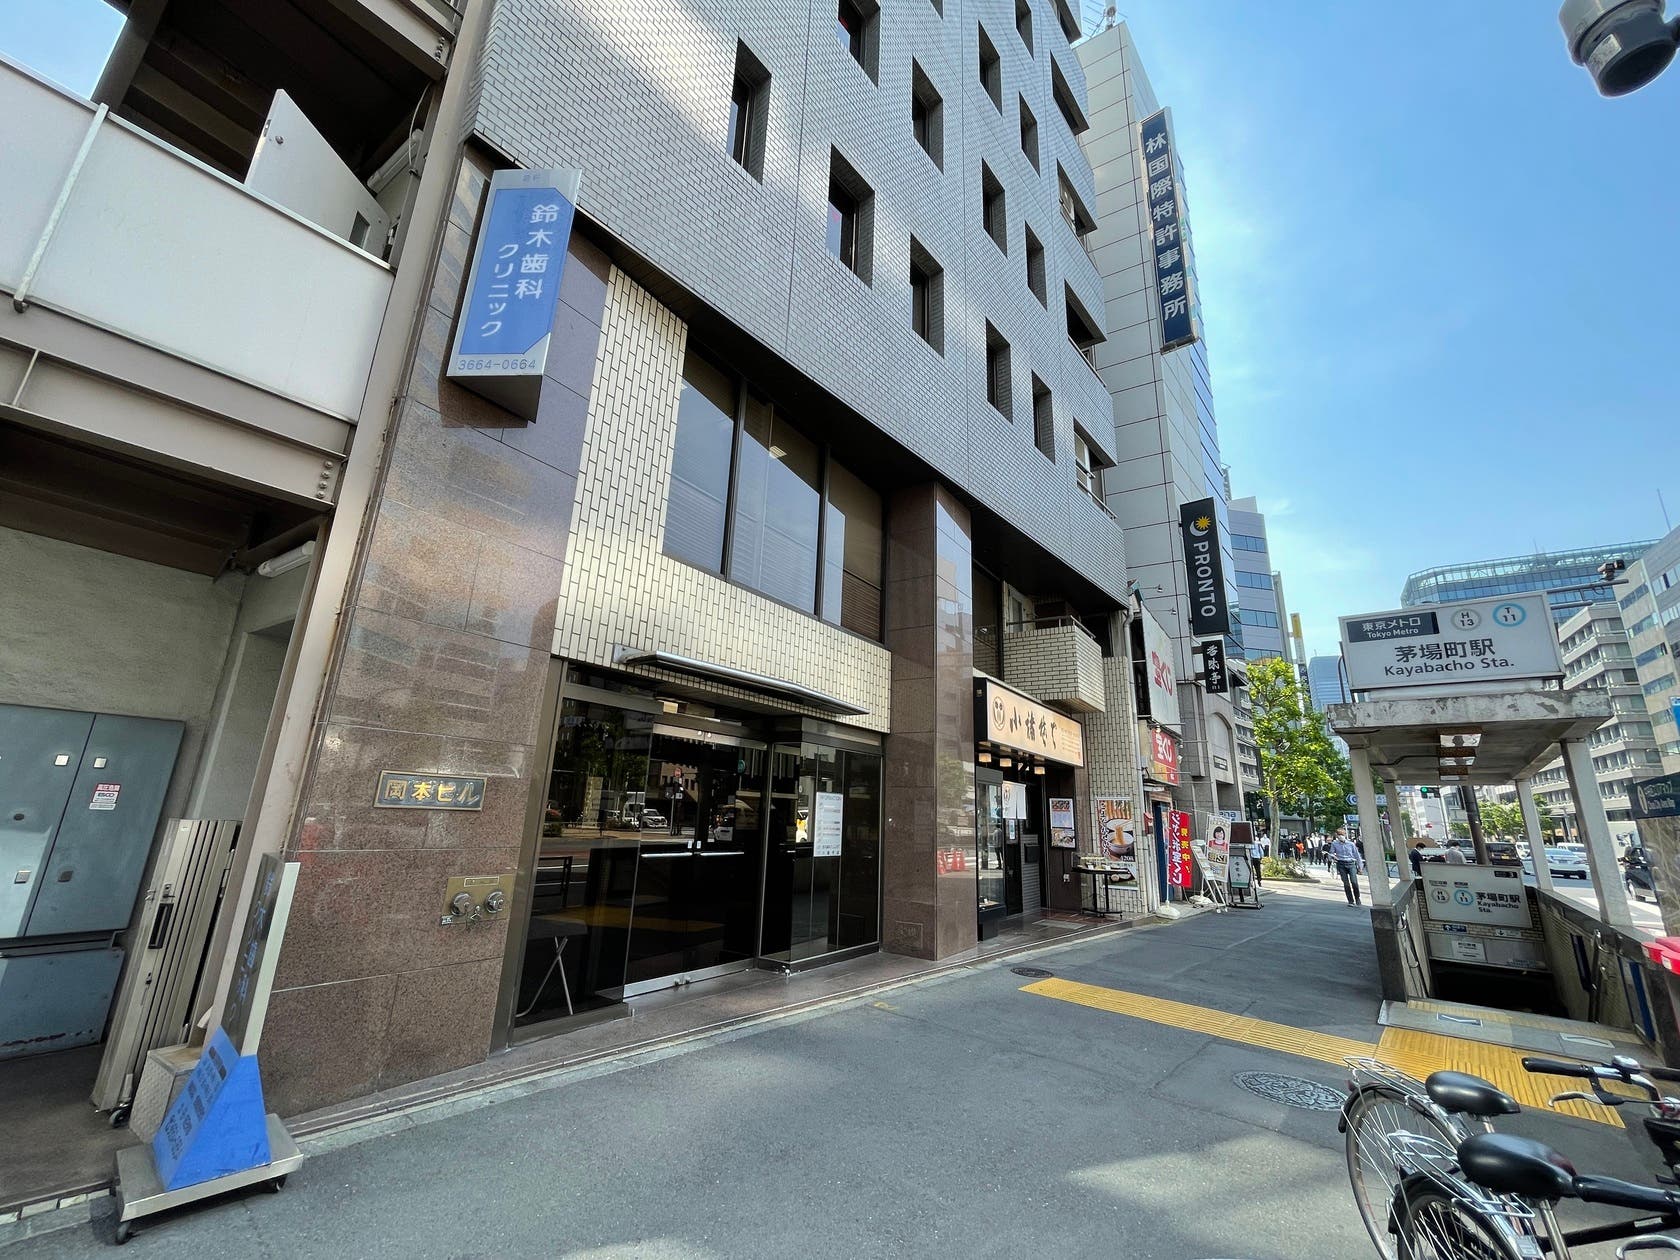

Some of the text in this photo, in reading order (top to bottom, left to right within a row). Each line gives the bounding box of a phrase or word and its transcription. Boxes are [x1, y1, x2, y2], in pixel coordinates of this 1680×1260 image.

[1145, 132, 1186, 321] 林国際特許事務所
[514, 203, 560, 300] 鈴木歯科
[480, 243, 519, 337] クリニック
[457, 358, 537, 371] 3664-0664
[1193, 541, 1217, 617] PRONTO
[1361, 616, 1421, 632] 東京メトロ
[1460, 618, 1475, 627] 13
[1461, 611, 1470, 619] H
[1502, 614, 1516, 622] 11
[1367, 627, 1419, 639] Tokyo Metro
[1394, 638, 1496, 663] 茅場町駅
[1384, 657, 1515, 678] Kayabacho Sta.
[384, 779, 479, 804] 岡本ビル
